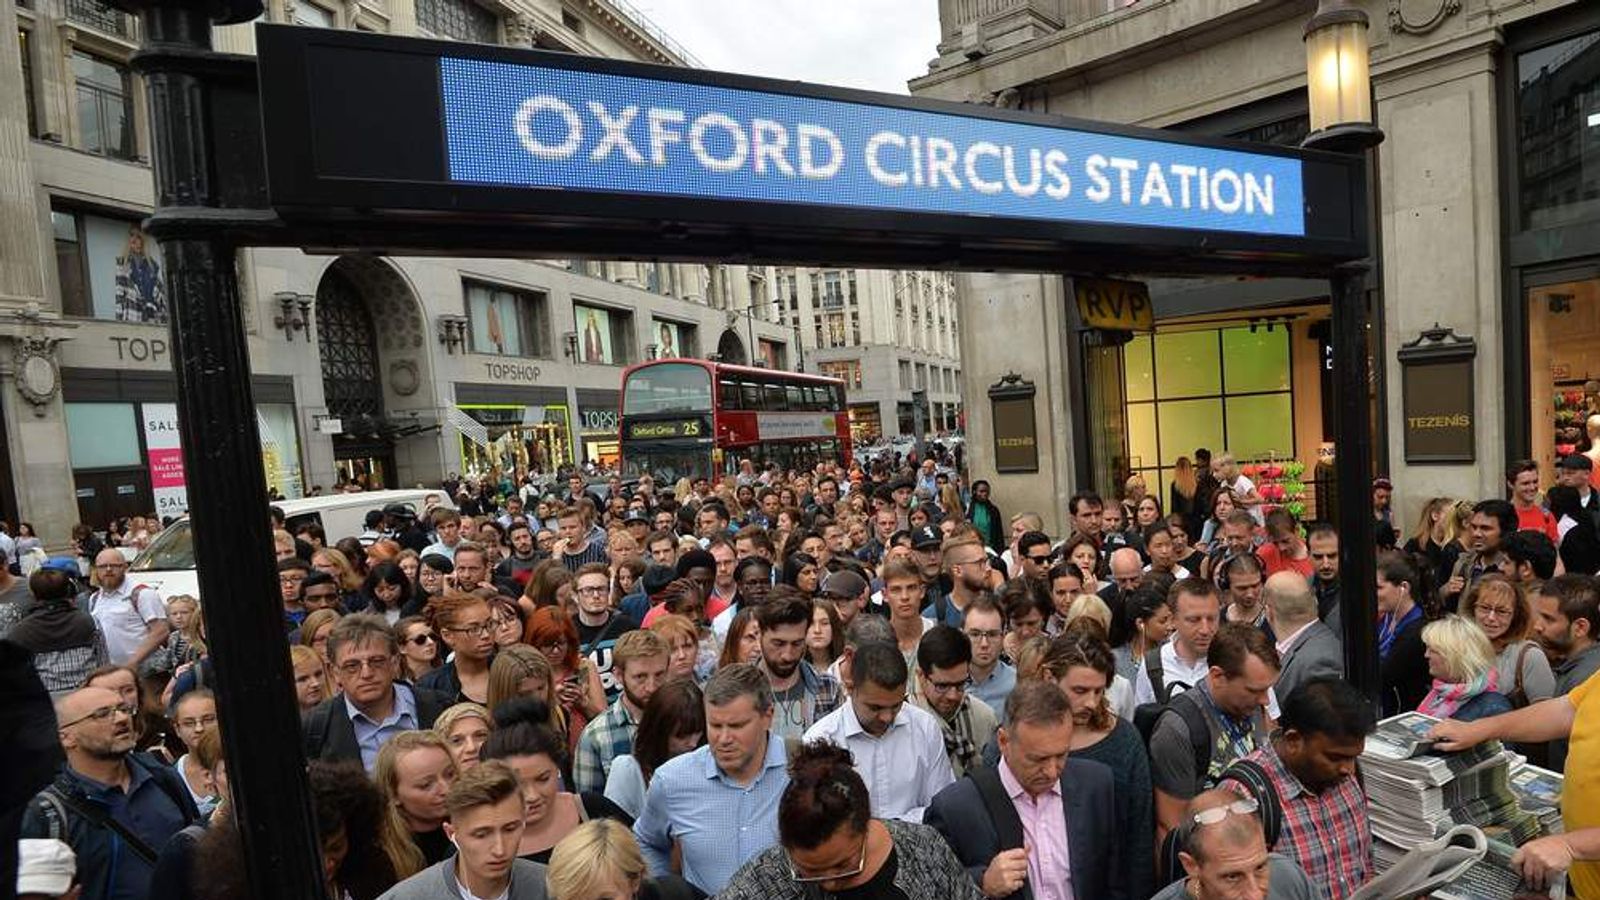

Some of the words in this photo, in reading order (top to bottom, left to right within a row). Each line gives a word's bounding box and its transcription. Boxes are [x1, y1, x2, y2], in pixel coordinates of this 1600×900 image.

[513, 95, 845, 180] OXFORD
[865, 130, 1071, 201] CIRCUS
[1085, 153, 1276, 216] STATION
[1085, 287, 1146, 321] RVP
[486, 363, 541, 381] TOPSHOP
[683, 422, 699, 435] 25
[1408, 415, 1470, 428] TEZENIS
[160, 497, 185, 508] SAL
